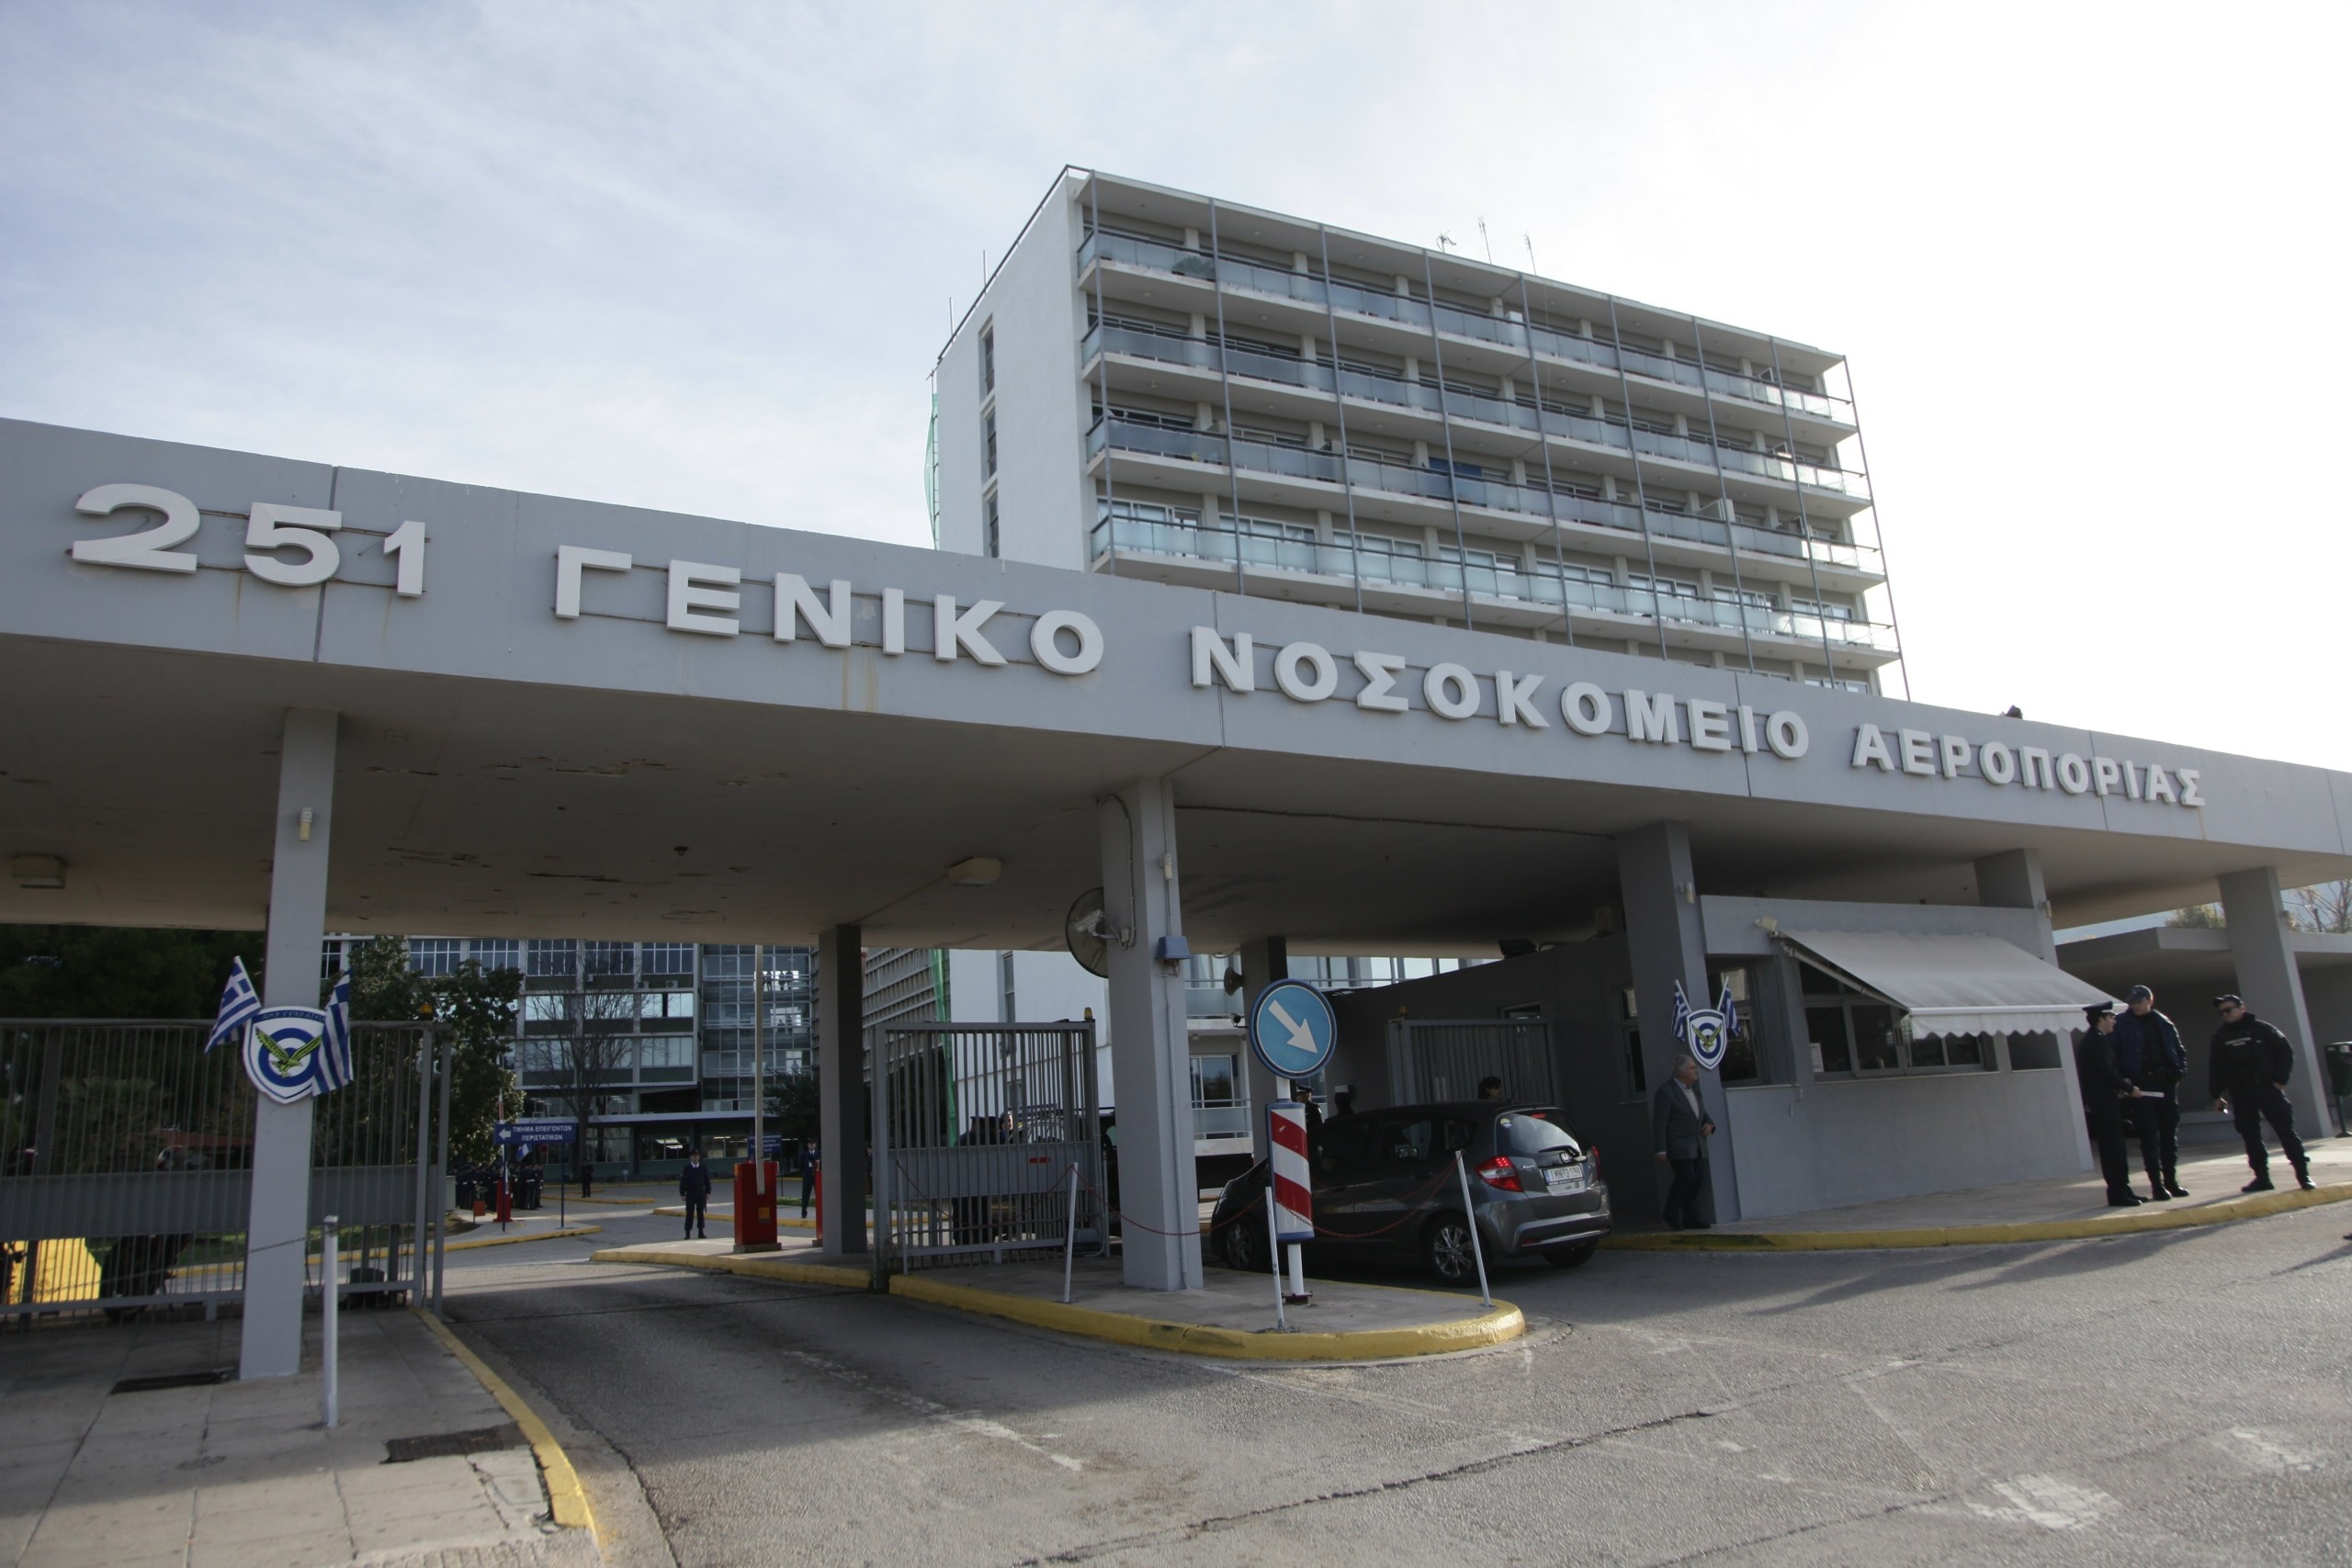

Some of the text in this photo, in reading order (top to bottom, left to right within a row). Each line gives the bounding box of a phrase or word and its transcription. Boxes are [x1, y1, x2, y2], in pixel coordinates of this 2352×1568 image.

[73, 483, 2206, 807] 251 ΓΕΝΙΚΟ ΝΟΣΟΚΟΜΕΙΟ ΑΕΡΟΠΟΡΙΑΣ
